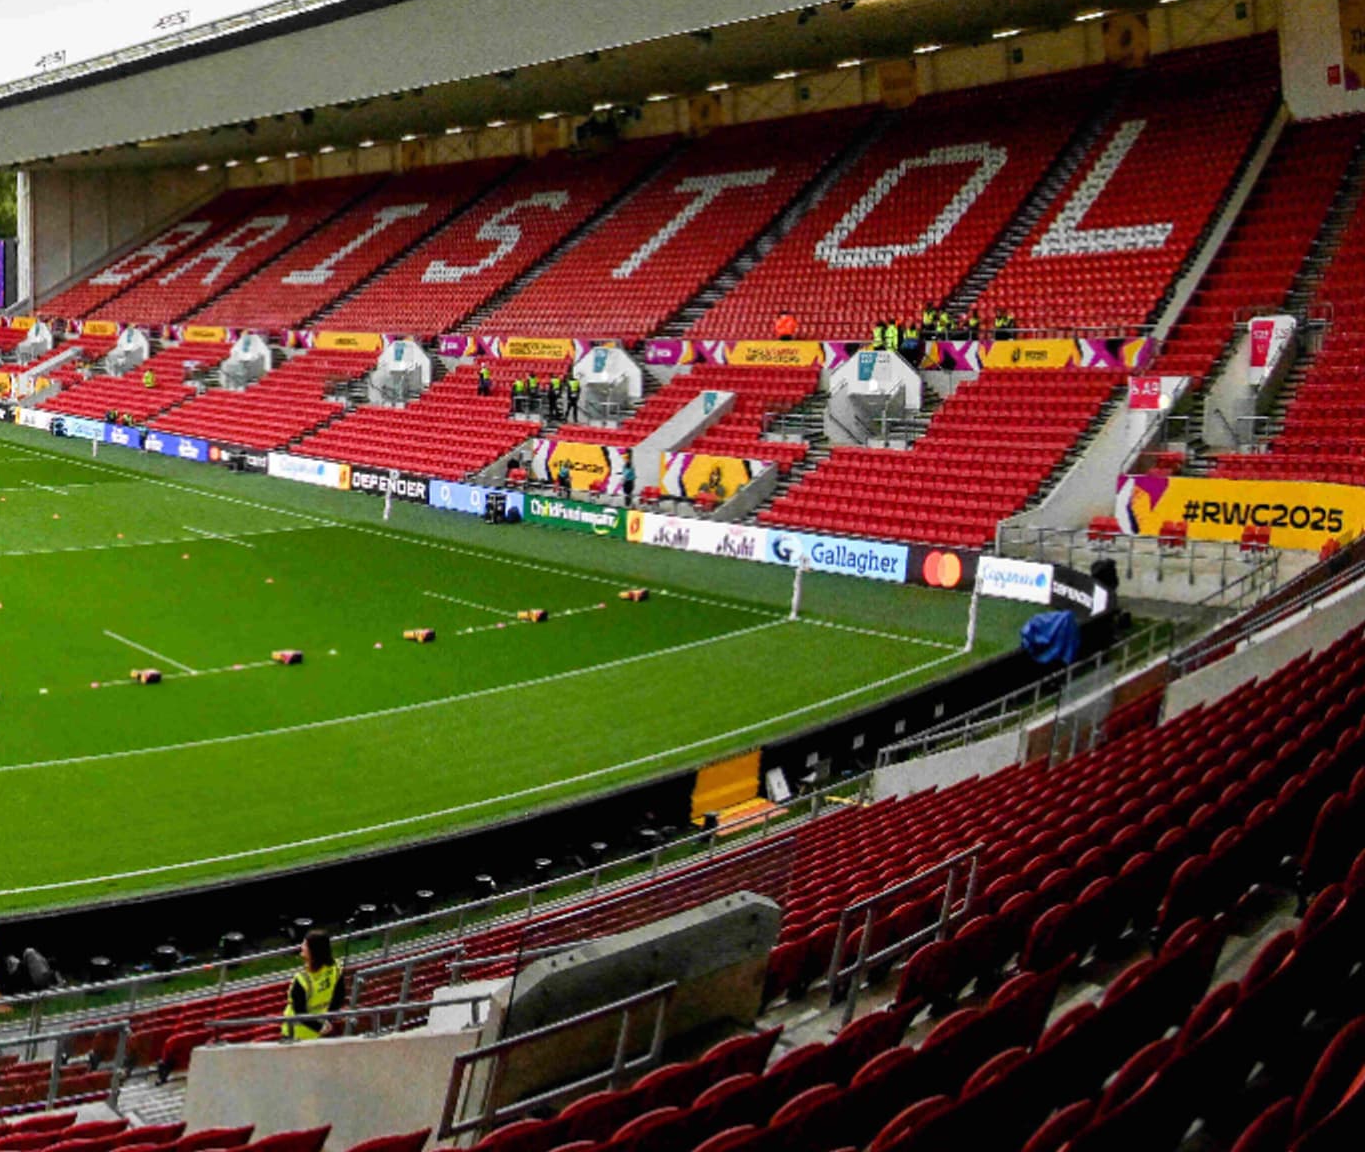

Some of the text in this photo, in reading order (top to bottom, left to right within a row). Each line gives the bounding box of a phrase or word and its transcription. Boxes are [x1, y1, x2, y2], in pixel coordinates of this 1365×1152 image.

[351, 470, 427, 499] DEFENDER
[1182, 499, 1344, 533] #RWC2025
[810, 542, 899, 575] Gallagher
